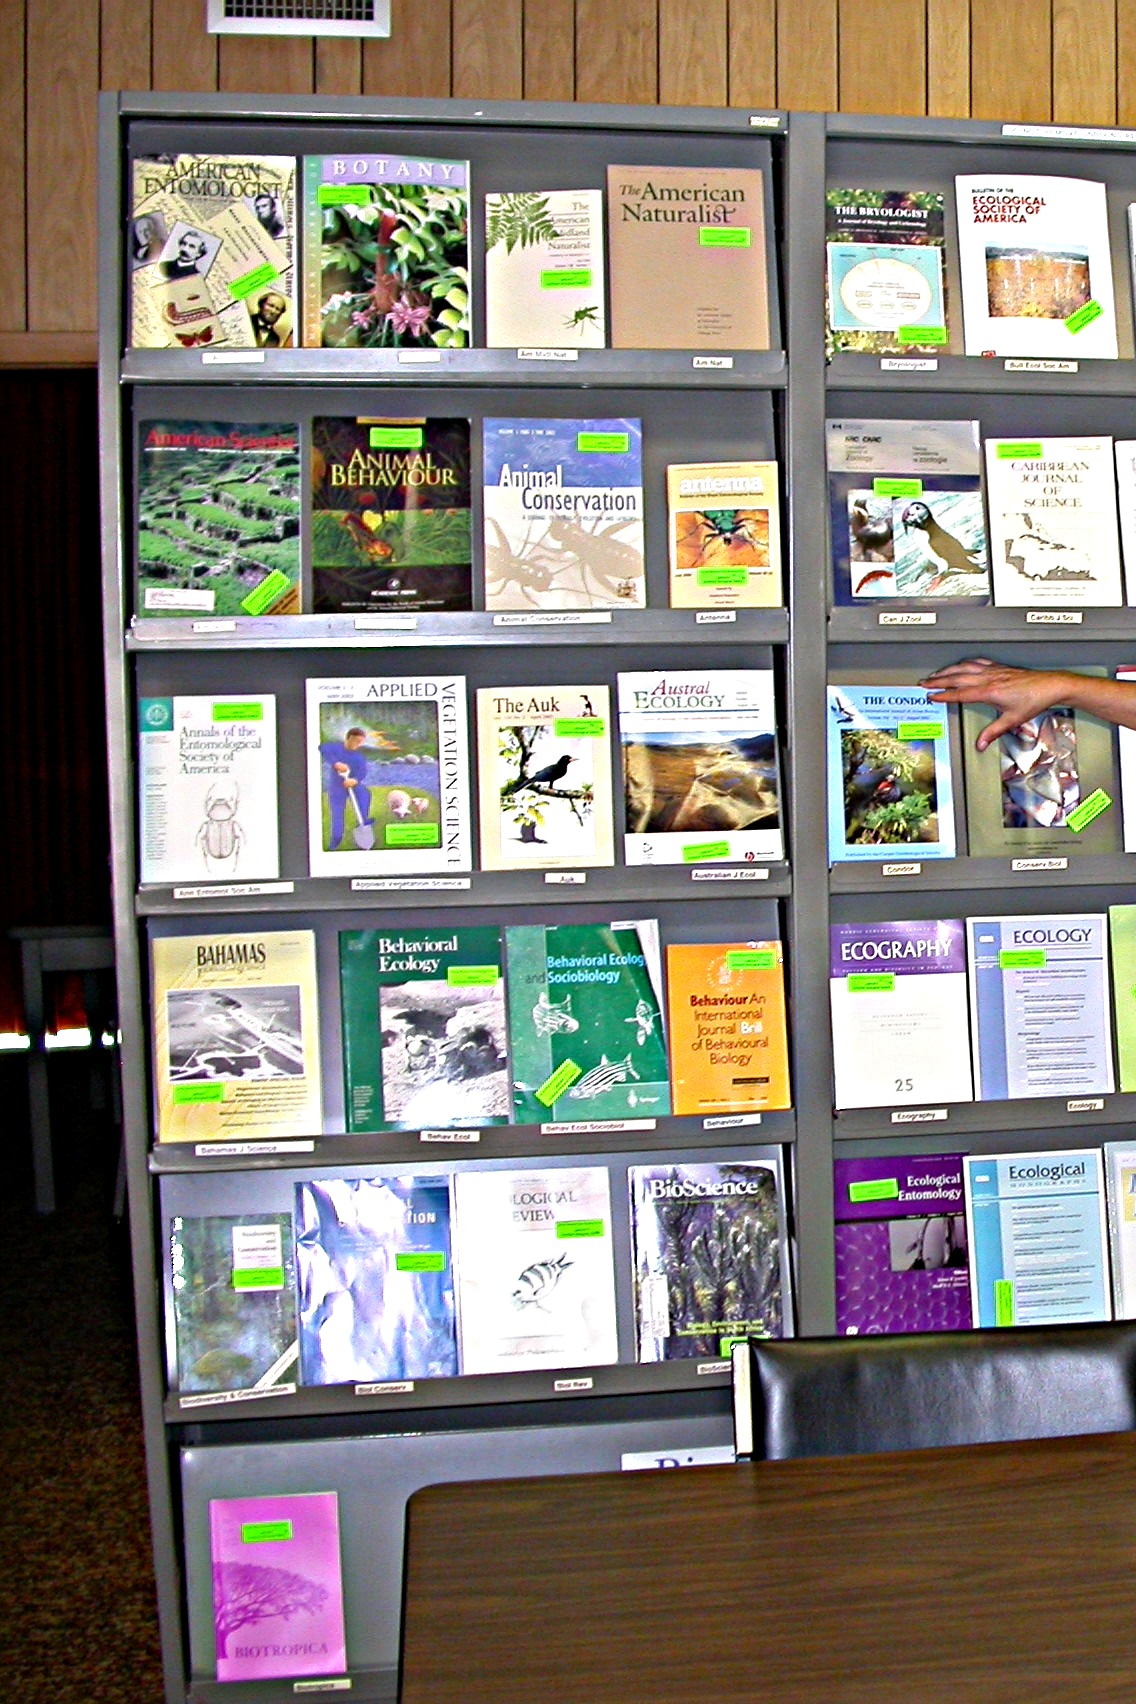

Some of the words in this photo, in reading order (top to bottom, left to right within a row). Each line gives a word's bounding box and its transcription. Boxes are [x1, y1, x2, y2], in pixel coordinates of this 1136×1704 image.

[165, 160, 261, 179] AMERICAN
[333, 160, 453, 179] BOTANY
[145, 178, 281, 198] ENTOMOLOGIST
[619, 184, 641, 196] The
[641, 182, 745, 202] American
[572, 202, 589, 211] The
[972, 196, 1047, 206] ECOLOGICAL
[621, 203, 736, 223] Naturalist
[834, 206, 857, 216] THE
[859, 206, 928, 219] BRYOLOGIST
[973, 204, 1021, 214] SOCIETY
[1025, 204, 1041, 215] OF
[550, 216, 590, 224] American
[973, 214, 1027, 223] AMERICA
[548, 240, 590, 250] Naturalist
[145, 430, 224, 449] American
[228, 433, 295, 449] Scientist
[349, 449, 437, 469] ANIMAL
[1011, 462, 1089, 472] CARIBBEAN
[330, 464, 457, 486] BEHAVIOUR
[500, 464, 563, 489] Animal
[1020, 474, 1083, 483] JOURNAL
[679, 475, 763, 494] antenna
[1043, 486, 1060, 495] OF
[522, 487, 636, 511] Conservation
[1024, 498, 1082, 508] SCIENCE
[367, 682, 438, 698] APPLIED
[651, 679, 710, 696] Austral
[493, 698, 525, 714] The
[528, 697, 560, 713] Auk
[633, 691, 725, 709] ECOLOGY
[863, 696, 885, 705] THE
[888, 696, 933, 705] CONDOR
[180, 726, 220, 737] Annals
[223, 725, 235, 737] of
[237, 725, 256, 737] the
[441, 682, 458, 790] VEGETATION
[180, 737, 262, 750] Entomological
[179, 751, 220, 764] Society
[222, 750, 235, 761] of
[179, 764, 230, 774] America
[445, 793, 461, 866] SCIENCE
[694, 871, 731, 880] Australian
[355, 880, 383, 889] Applied
[388, 880, 429, 889] Vegetation
[1014, 928, 1092, 944] ECOLOGY
[379, 935, 458, 955] Behavioral
[841, 938, 953, 962] ECOGRAPHY
[197, 943, 266, 966] BAHAMAS
[547, 954, 607, 968] Behavioral
[609, 953, 646, 966] Ecolog
[379, 954, 441, 973] Ecology
[548, 970, 620, 984] Sociobiology
[690, 995, 748, 1007] Behaviour
[749, 995, 766, 1004] An
[694, 1008, 764, 1020] International
[697, 1023, 735, 1038] Journal
[691, 1039, 703, 1050] of
[704, 1037, 768, 1049] Behavioural
[710, 1053, 752, 1067] Biology
[895, 1079, 914, 1092] 25
[589, 1122, 625, 1130] Sociobiol
[707, 1118, 743, 1126] Behaviour
[427, 1133, 451, 1141] Behav
[454, 1133, 471, 1141] Ecol
[201, 1146, 238, 1154] Bahamas
[247, 1145, 277, 1153] Science
[1009, 1162, 1085, 1181] Ecological
[907, 1174, 961, 1188] Ecological
[650, 1179, 758, 1199] BioScience
[898, 1187, 962, 1202] Entomology
[181, 1391, 228, 1405] Biodiversity
[230, 1391, 236, 1399] &
[238, 1385, 288, 1398] Conservation
[377, 1385, 406, 1393] Conserv
[234, 1642, 329, 1658] BIOTROPICA
